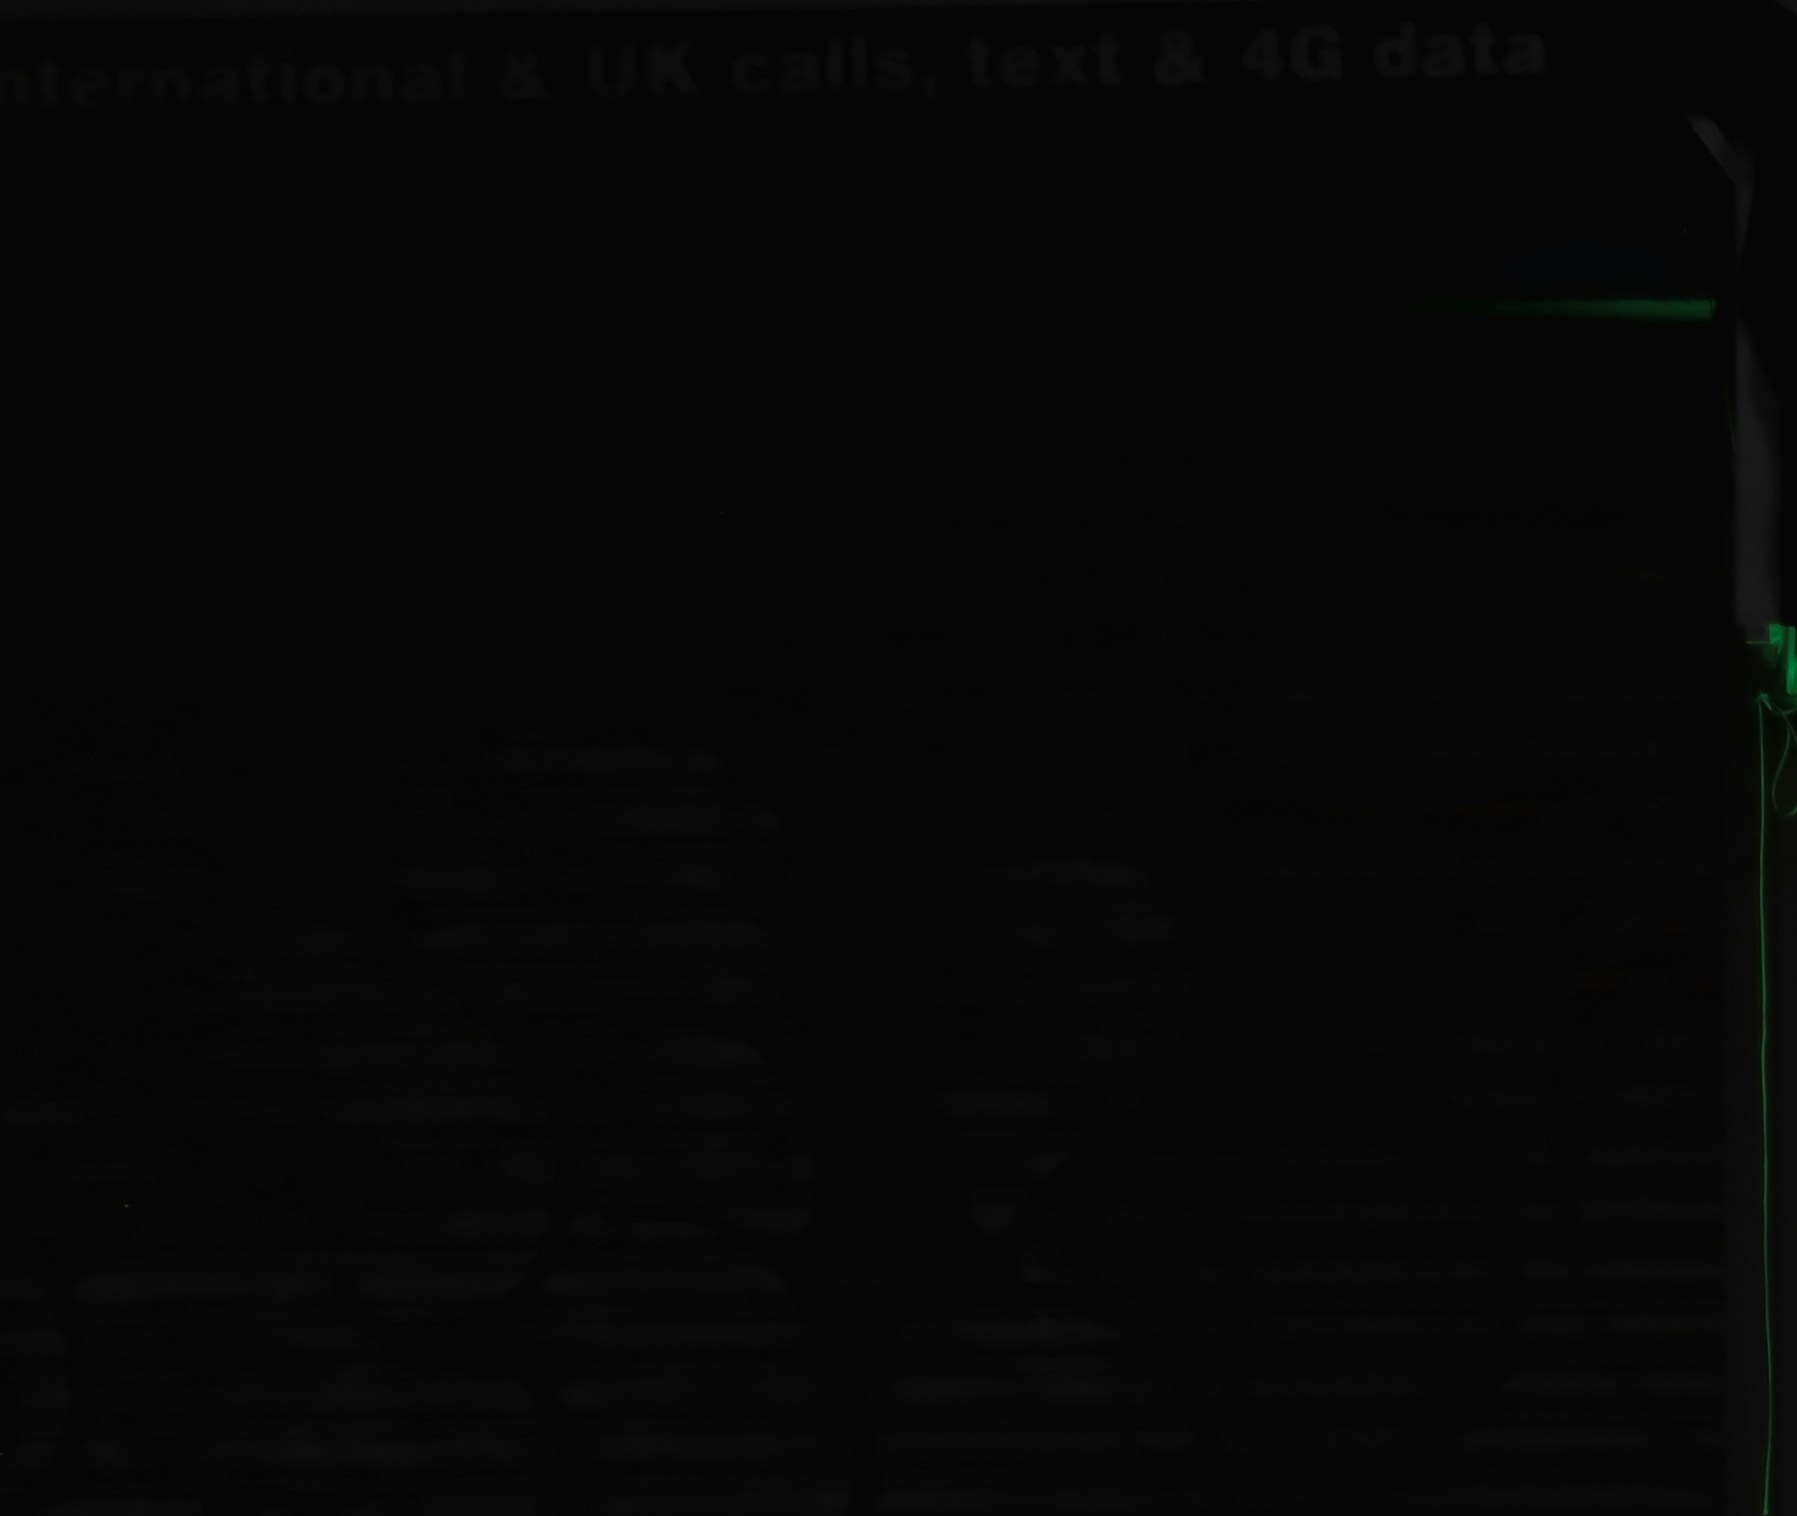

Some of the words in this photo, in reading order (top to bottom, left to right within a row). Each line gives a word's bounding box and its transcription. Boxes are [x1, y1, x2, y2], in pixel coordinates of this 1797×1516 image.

[499, 47, 549, 100] &
[586, 41, 699, 97] UK
[731, 34, 936, 99] calls,
[966, 31, 1122, 88] text
[1153, 28, 1207, 86] &
[1241, 24, 1344, 82] 4G
[1373, 22, 1546, 78] data
